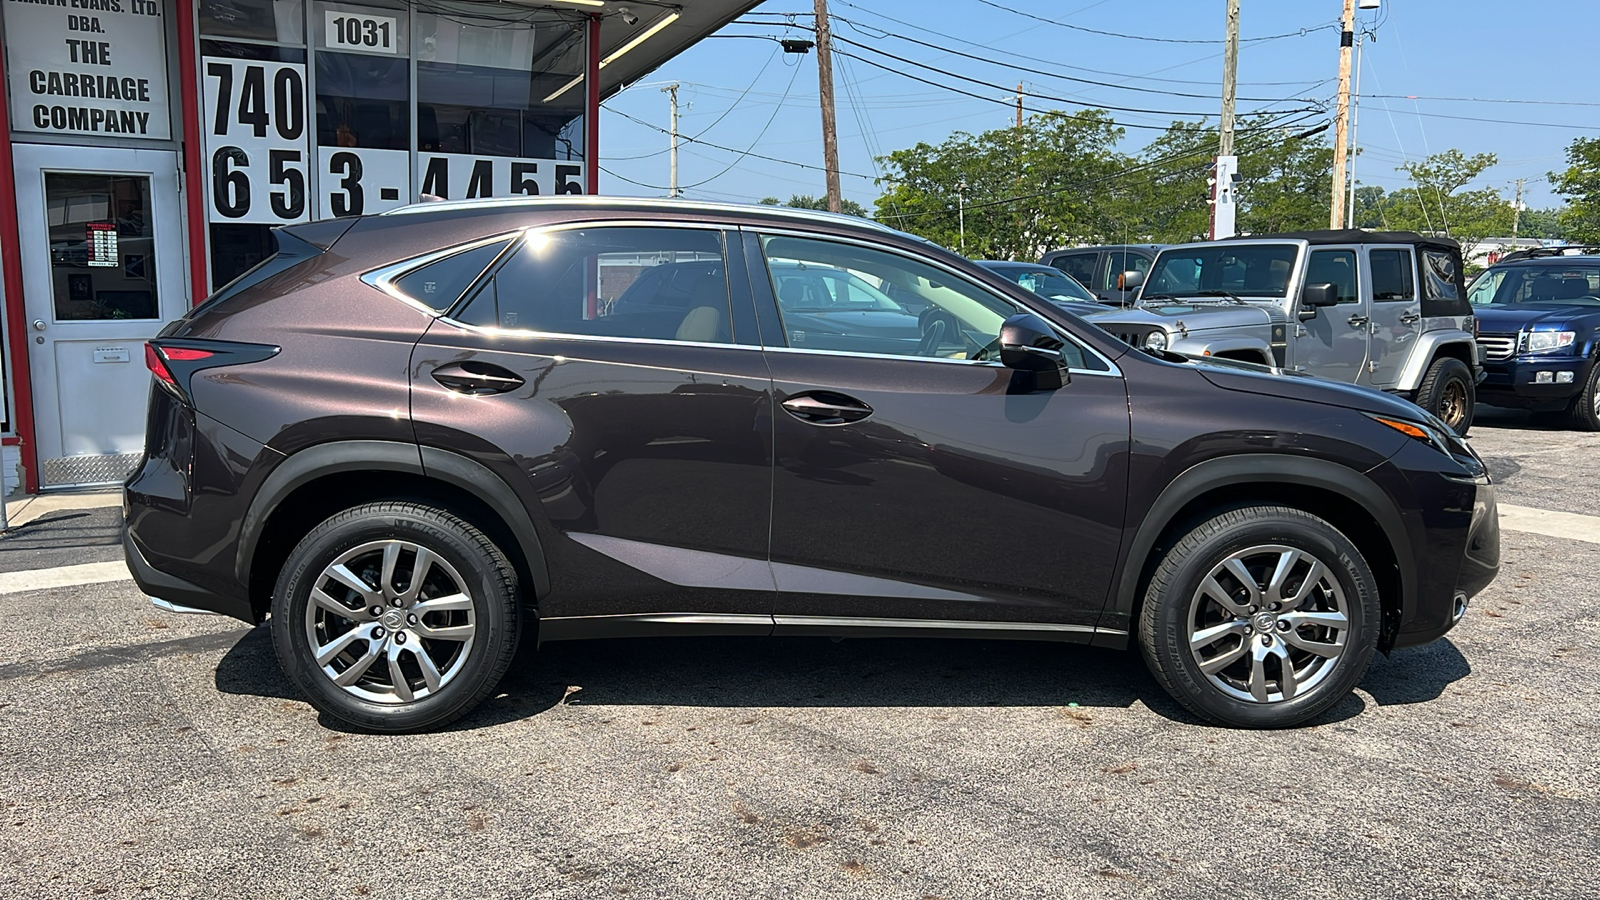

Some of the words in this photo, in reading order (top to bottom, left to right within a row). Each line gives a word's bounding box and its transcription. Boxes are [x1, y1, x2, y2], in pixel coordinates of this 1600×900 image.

[67, 14, 106, 34] DBA.
[131, 0, 161, 17] LTD.
[333, 17, 390, 48] 1031
[65, 39, 112, 66] THE
[29, 69, 150, 102] CARRIAGE
[207, 62, 304, 140] 740
[33, 104, 150, 135] COMPANY
[1166, 624, 1192, 683] MICHELIN
